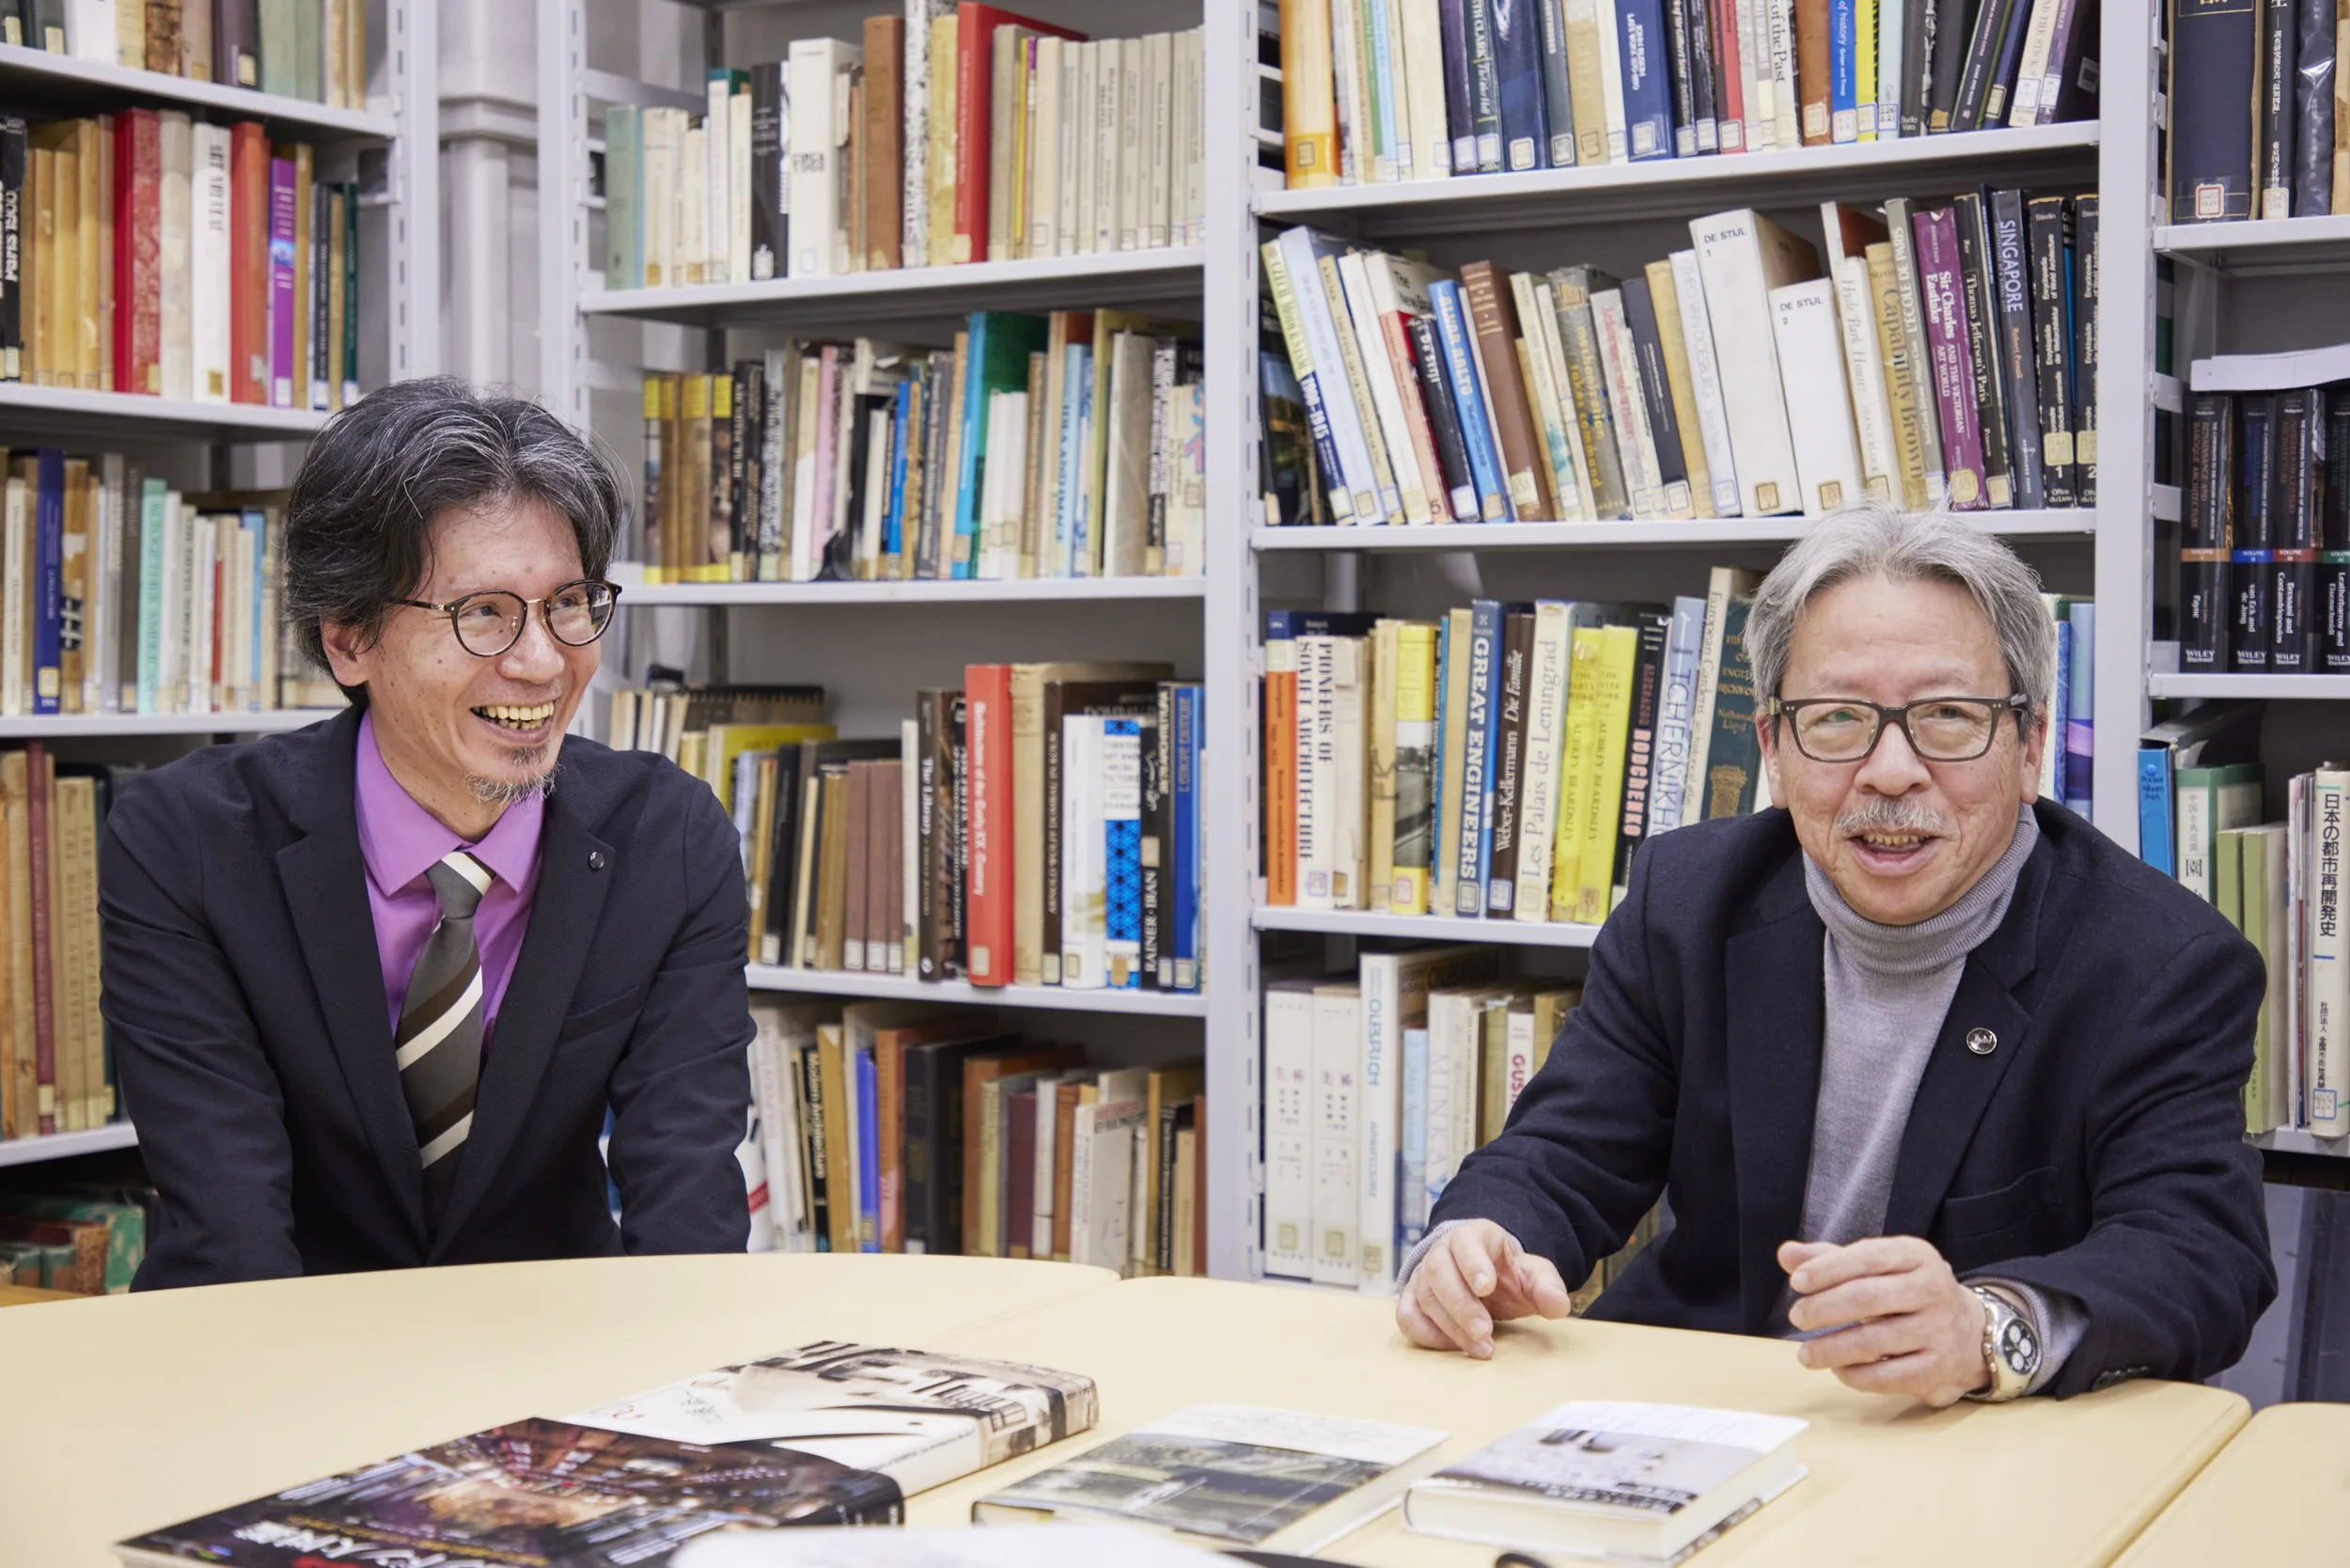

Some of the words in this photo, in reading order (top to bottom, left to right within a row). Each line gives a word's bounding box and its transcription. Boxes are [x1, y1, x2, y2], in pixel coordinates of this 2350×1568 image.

[1770, 5, 1784, 21] of
[1839, 1, 1849, 9] of
[1773, 24, 1784, 49] the
[1839, 13, 1849, 44] history
[1774, 51, 1788, 83] Past
[4, 190, 18, 231] 1900
[1703, 234, 1717, 243] DE
[1719, 227, 1747, 241] STIJL
[1891, 226, 1907, 261] PARIS
[1998, 220, 2023, 313] SINGAPORE
[2046, 233, 2057, 271] Architecture
[1894, 263, 1910, 281] DE
[1939, 271, 1952, 290] Sir
[2048, 271, 2058, 290] World
[1779, 303, 1794, 311] DE
[1795, 296, 1824, 309] STIJL
[1841, 280, 1858, 313] Hyde
[1926, 274, 1941, 324] Eastlake
[1965, 274, 1980, 320] Thomas
[1438, 295, 1461, 343] ALVAR
[1782, 317, 1789, 325] 2
[1846, 318, 1865, 344] Park
[1940, 291, 1957, 340] Charles
[1936, 346, 1947, 362] ART
[1946, 345, 1956, 364] AND
[1968, 321, 1985, 374] Jefferson's
[1883, 290, 1913, 400] Capability
[1900, 407, 1924, 479] Brown
[1937, 364, 1950, 398] WORLD
[1949, 366, 1960, 383] THE
[1976, 376, 1990, 404] Paris
[1951, 384, 1964, 434] VICTORIAN
[1570, 365, 1586, 409] takes
[1578, 413, 1603, 488] command
[2055, 465, 2063, 478] 1
[2087, 465, 2097, 478] 2
[1431, 500, 1442, 515] 5
[2191, 593, 2201, 619] Payne
[2239, 591, 2248, 602] de
[2248, 583, 2256, 599] van
[2285, 582, 2295, 617] Bressani
[2336, 572, 2347, 628] Leatherbarrow
[1700, 590, 1723, 656] European
[2248, 618, 2257, 633] and
[2285, 619, 2295, 635] and
[2336, 630, 2346, 646] and
[2186, 650, 2215, 658] WILEY
[2237, 650, 2266, 659] WILEY
[1298, 641, 1314, 706] SOVIET
[1318, 644, 1334, 734] PIONEERS
[1468, 637, 1490, 724] GREAT
[1695, 660, 1715, 716] Gardens
[1530, 640, 1560, 743] Leningrad
[1503, 698, 1521, 723] Die
[922, 757, 933, 781] The
[1318, 741, 1334, 766] OF
[1529, 749, 1549, 775] de
[1298, 715, 1314, 862] ARCHITECTURE
[1460, 729, 1484, 879] ENGINEERS
[1496, 731, 1518, 852] Weber-Kellermann
[920, 786, 934, 836] Library
[973, 800, 985, 829] Early
[1524, 782, 1547, 836] Palais
[1588, 774, 1604, 844] BEARDSLEY
[1522, 845, 1542, 878] Les
[2319, 793, 2341, 938] 日本の都市再開発史
[1145, 870, 1158, 909] IRAN
[1145, 917, 1158, 973] RAINER
[1367, 998, 1383, 1086] OLBRICH
[807, 1052, 821, 1102] Modern
[1429, 1054, 1450, 1167] MINKA
[811, 1104, 827, 1180] Architecture
